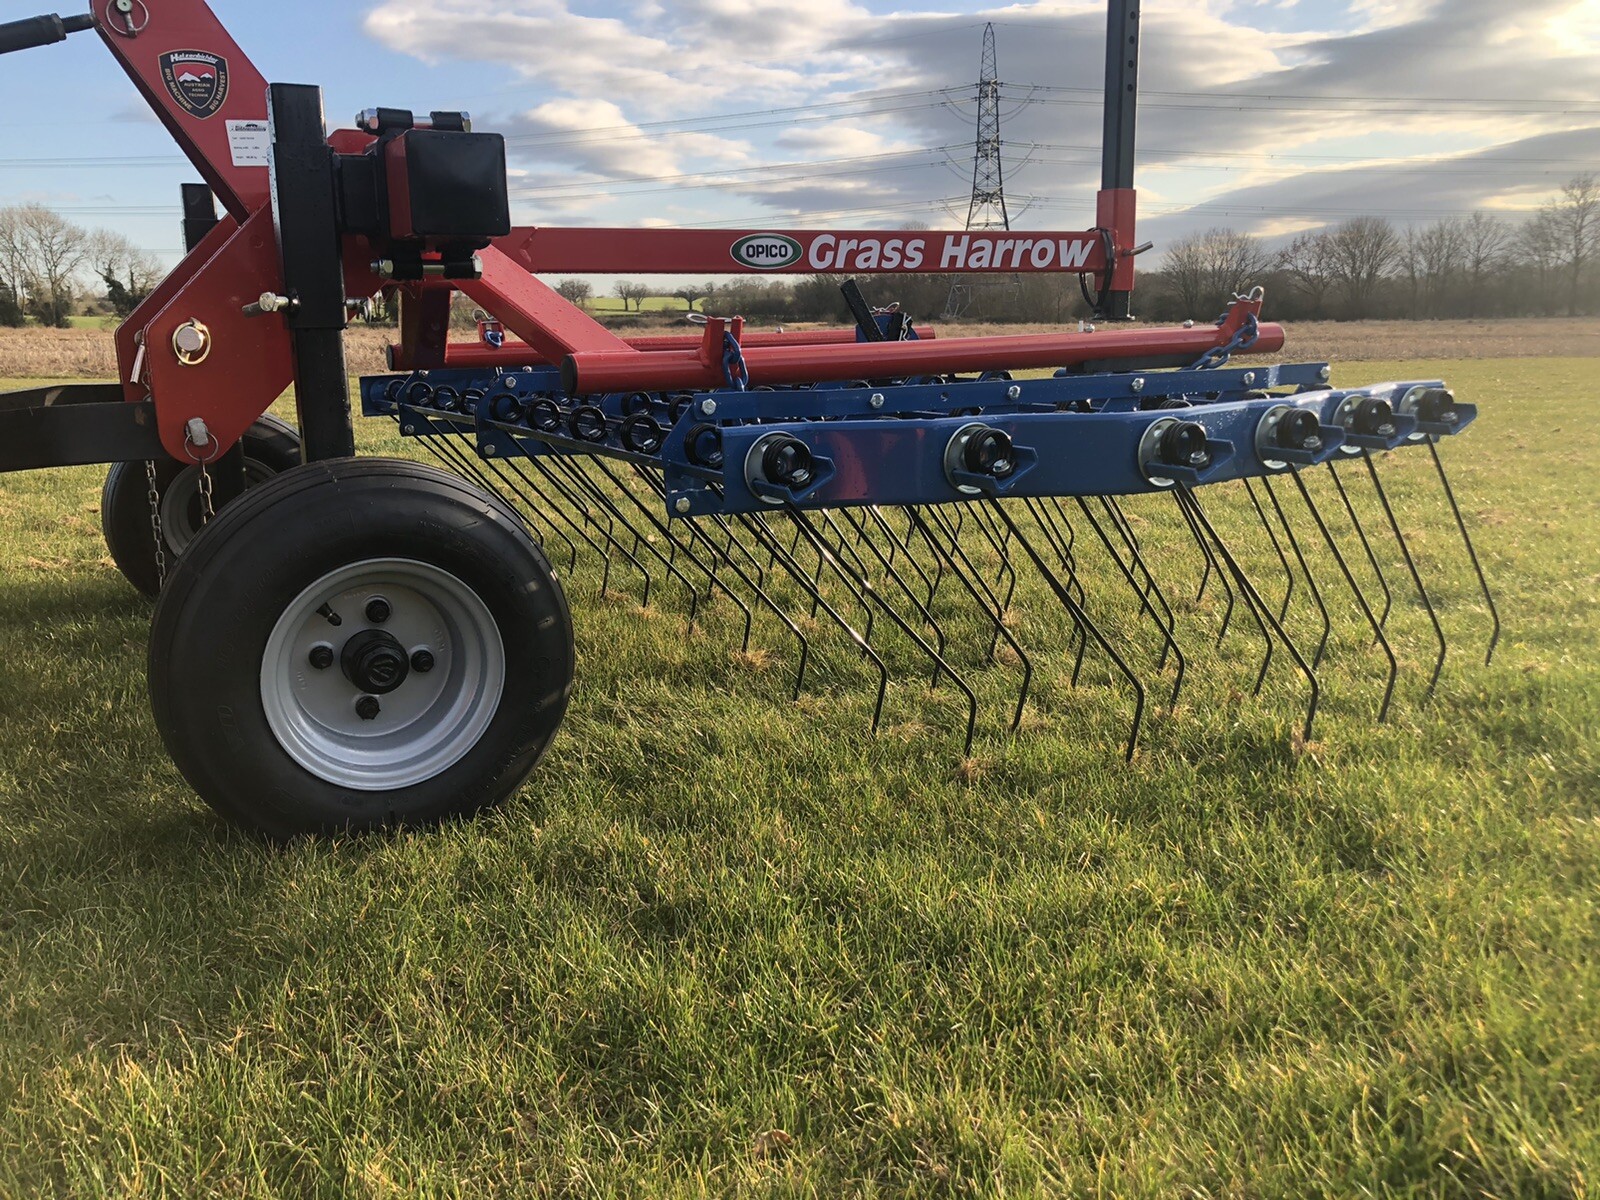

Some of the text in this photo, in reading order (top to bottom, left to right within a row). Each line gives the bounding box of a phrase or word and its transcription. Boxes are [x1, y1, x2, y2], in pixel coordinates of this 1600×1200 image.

[165, 68, 193, 111] BIG MACHINE
[209, 71, 225, 111] BIG HARVEST
[745, 243, 788, 258] OPICO
[808, 234, 1095, 269] Grass Harrow
